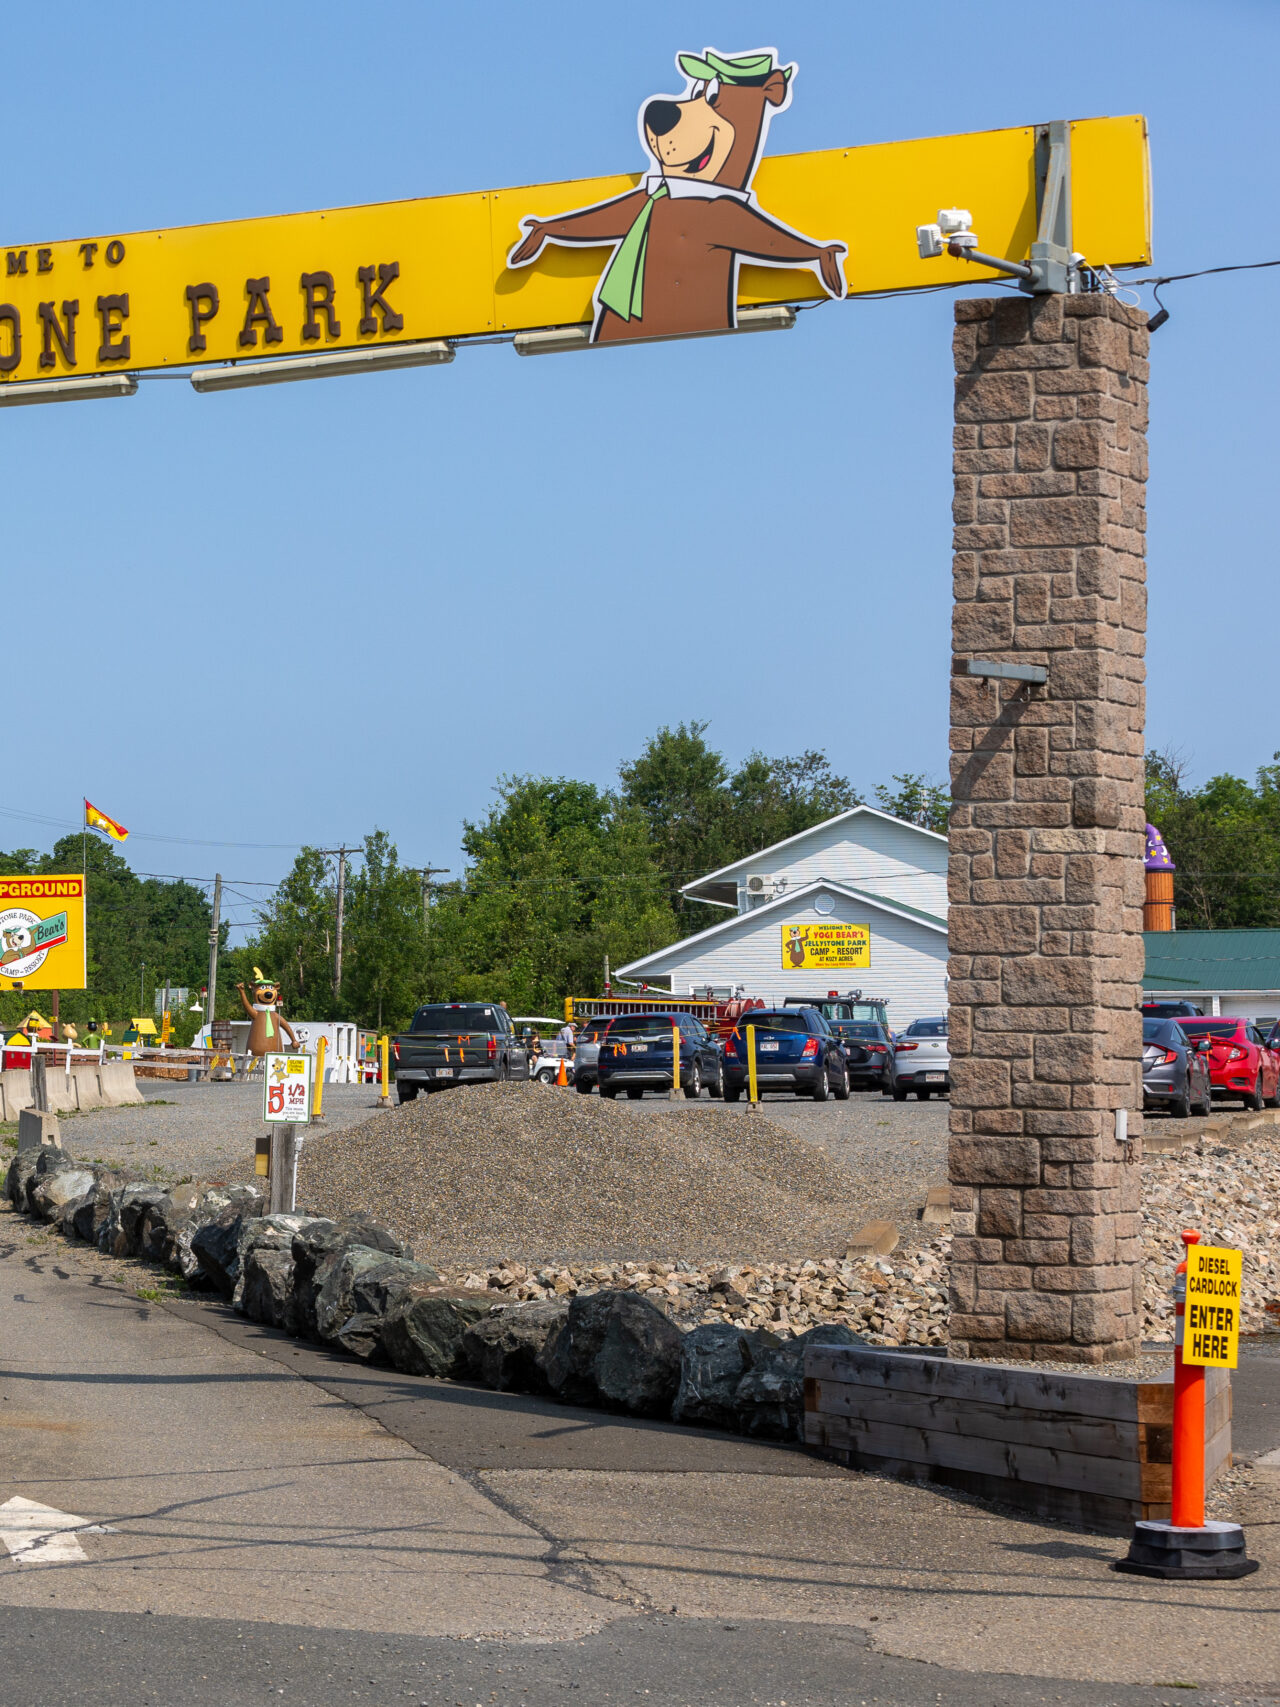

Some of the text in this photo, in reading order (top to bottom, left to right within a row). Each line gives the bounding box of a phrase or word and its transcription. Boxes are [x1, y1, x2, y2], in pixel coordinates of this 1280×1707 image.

[80, 240, 126, 267] TO
[186, 261, 404, 352] PARK
[18, 912, 34, 925] PARK
[37, 919, 65, 940] Bear's
[0, 966, 20, 976] CAMP
[24, 951, 45, 974] RESORT
[810, 948, 830, 956] CAMP
[837, 947, 863, 955] RESORT
[268, 1083, 305, 1114] 5 1/2
[1199, 1256, 1230, 1275] DIESEL
[1189, 1276, 1238, 1297] CARDLOCK
[1190, 1304, 1234, 1332] ENTER
[1192, 1333, 1229, 1360] HERE
